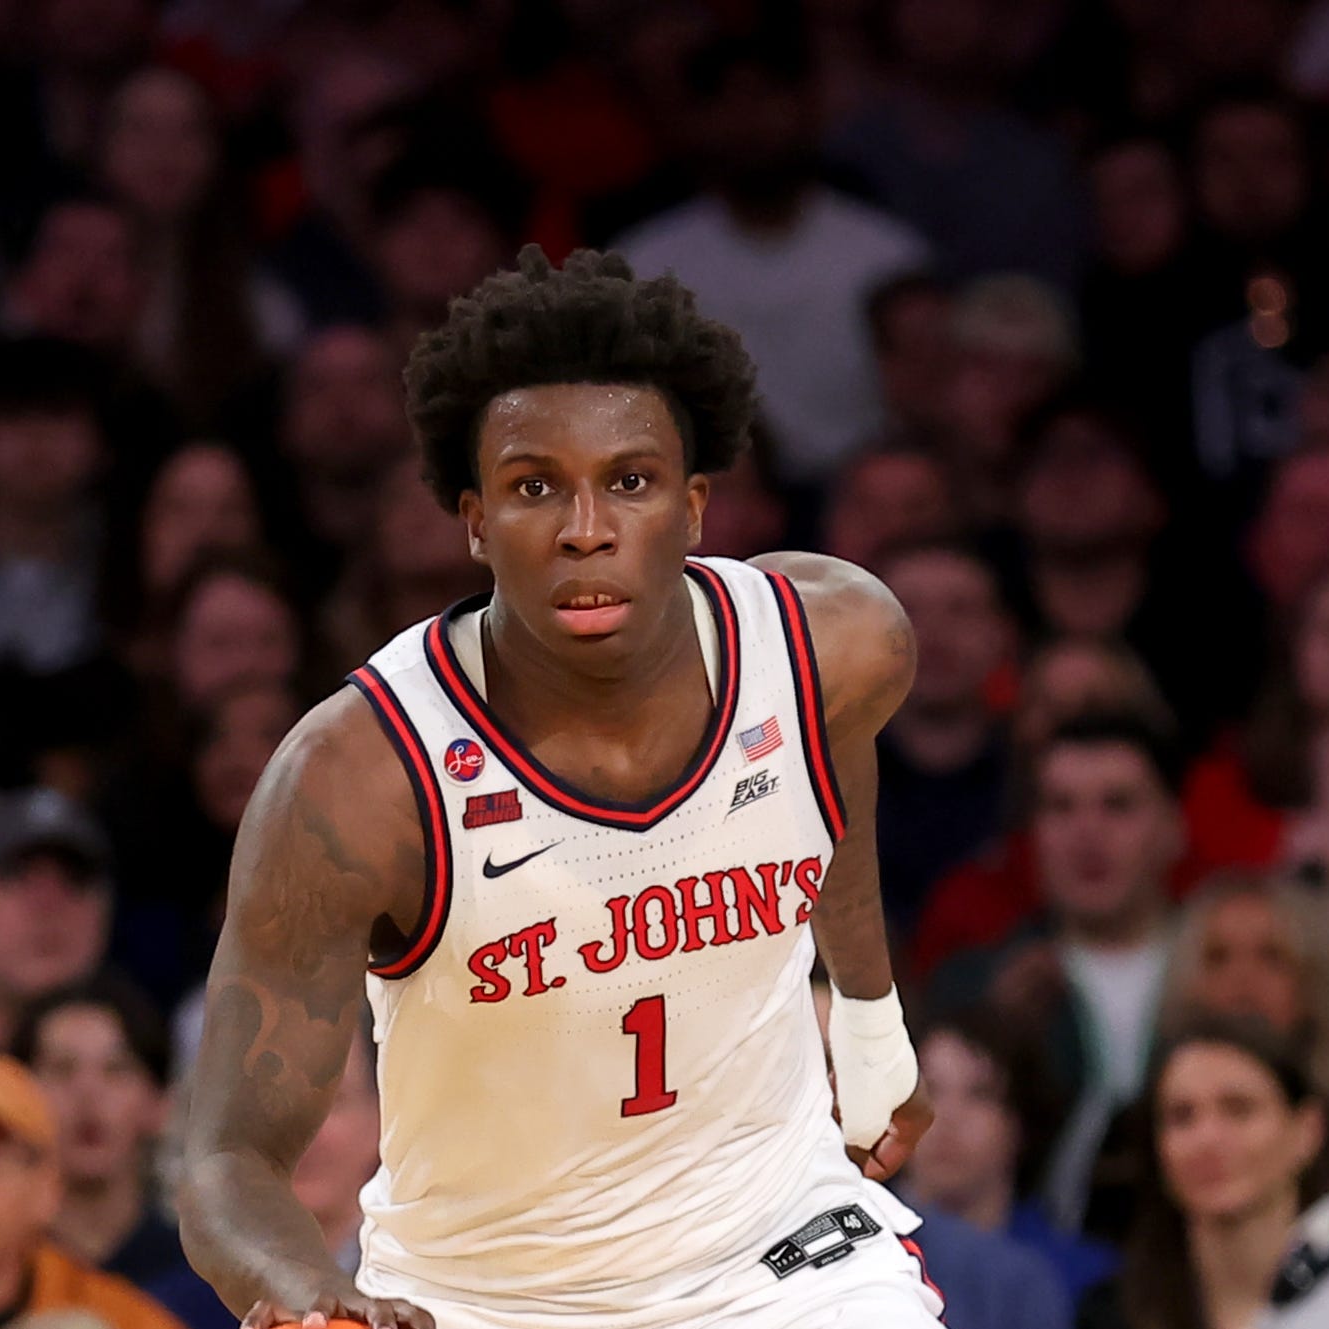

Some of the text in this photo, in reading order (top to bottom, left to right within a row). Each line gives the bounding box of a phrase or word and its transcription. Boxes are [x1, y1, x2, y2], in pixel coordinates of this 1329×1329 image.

[730, 776, 780, 808] EAST
[735, 769, 769, 794] BIG
[468, 855, 823, 1003] ST. JOHN'S
[621, 994, 678, 1118] 1
